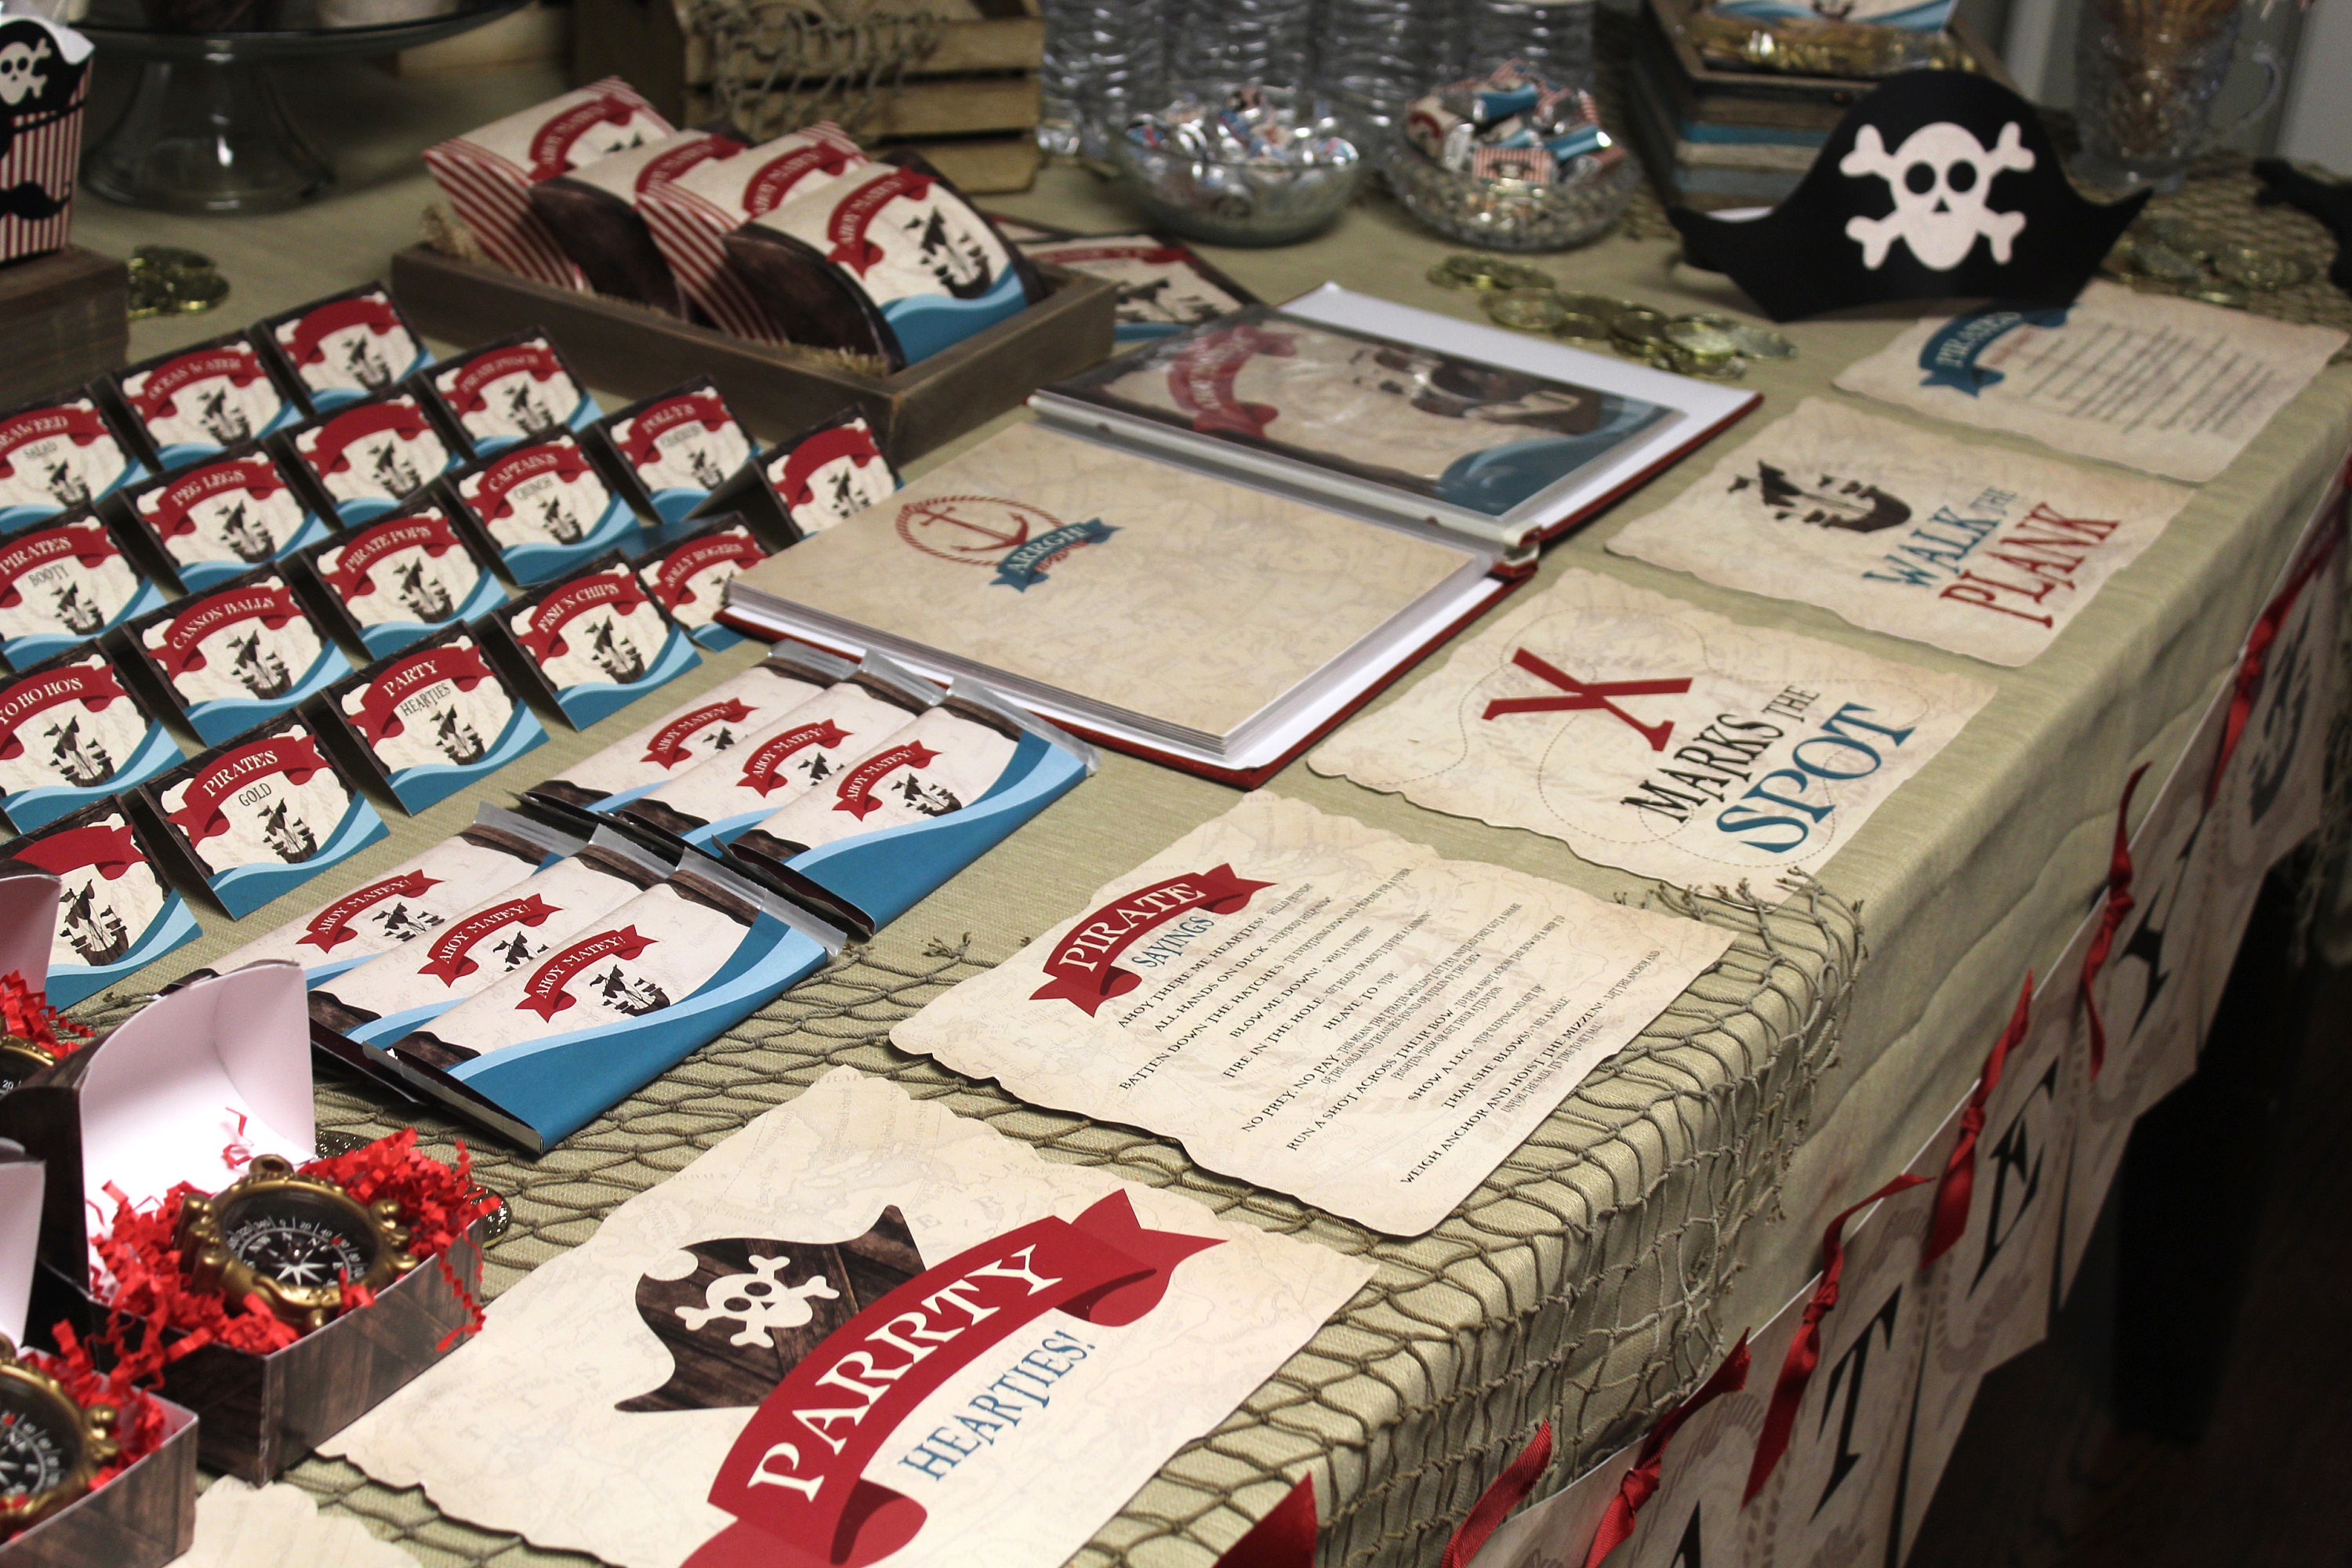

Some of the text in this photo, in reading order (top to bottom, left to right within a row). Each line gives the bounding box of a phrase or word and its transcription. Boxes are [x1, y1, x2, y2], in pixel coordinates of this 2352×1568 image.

[172, 479, 202, 507] PEG
[0, 536, 73, 575] PIRATES
[344, 524, 432, 573] PIRATE POPS
[1861, 486, 2018, 586] WALK THE
[1939, 501, 2121, 630] PLANK
[27, 562, 70, 587] BOOTY
[172, 596, 275, 651] CANNON BALLS
[536, 604, 564, 633] FISH
[575, 582, 621, 606] CHIPS
[16, 688, 43, 708] HO
[383, 659, 439, 697] PARTY
[399, 681, 452, 718] HEARTIES
[1481, 647, 1693, 752] X
[202, 750, 279, 797] PIRATES
[752, 750, 778, 779] AHOY
[1620, 684, 1820, 823] MARKS THE
[1716, 702, 1916, 853] SPOT
[238, 782, 273, 808] GOLD
[846, 774, 868, 802] AHOY
[318, 878, 412, 935] AHOY MATEY!
[438, 903, 532, 965] AHOY MATEY!
[1058, 883, 1207, 972] PIRATE
[535, 935, 627, 1000] AHOY MATEY!
[1117, 916, 1266, 1028] AHOY THERE ME HEARTIES!
[1131, 916, 1214, 967] SAYINGS
[1154, 946, 1269, 1033] ALL HANDS ON DECK
[1229, 967, 1321, 1037] BLOW ME DOWN!
[1323, 986, 1378, 1030] HEAVE TO
[1118, 1051, 1171, 1090] BATTEN
[1167, 1022, 1208, 1053] DOWN
[1204, 1003, 1234, 1023] THE
[1230, 964, 1284, 1004] HATCHES
[1222, 1055, 1253, 1078] FIRE
[1249, 1042, 1268, 1056] IN
[1264, 1022, 1294, 1044] THE
[1289, 996, 1325, 1023] HOLE
[2, 1080, 14, 1091] 20
[1240, 1116, 1263, 1132] NO
[1261, 1090, 1298, 1117] PREY,
[1292, 1073, 1316, 1089] NO
[1312, 1054, 1339, 1074] PAY
[1286, 1127, 1316, 1151] RUN
[1314, 1120, 1326, 1129] A
[1322, 1091, 1358, 1118] SHOT
[1355, 1059, 1397, 1094] ACROSS
[1392, 1029, 1432, 1059] THEIR
[1426, 1008, 1454, 1030] BOW
[1399, 1149, 1442, 1183] WEIGH
[1440, 1109, 1489, 1152] ANCHOR
[1486, 1087, 1512, 1109] AND
[1508, 1057, 1545, 1087] HOIST
[1539, 1038, 1566, 1058] THE
[1561, 1001, 1605, 1039] MIZZEN!
[1407, 1072, 1442, 1100] SHOW
[1448, 1048, 1473, 1065] LEG
[1440, 1082, 1475, 1109] THAR
[1471, 1062, 1497, 1081] SHE
[1492, 1030, 1533, 1063] BLOWS!
[747, 1243, 1062, 1503] PARRTY
[898, 1330, 1097, 1480] HEARTIES!
